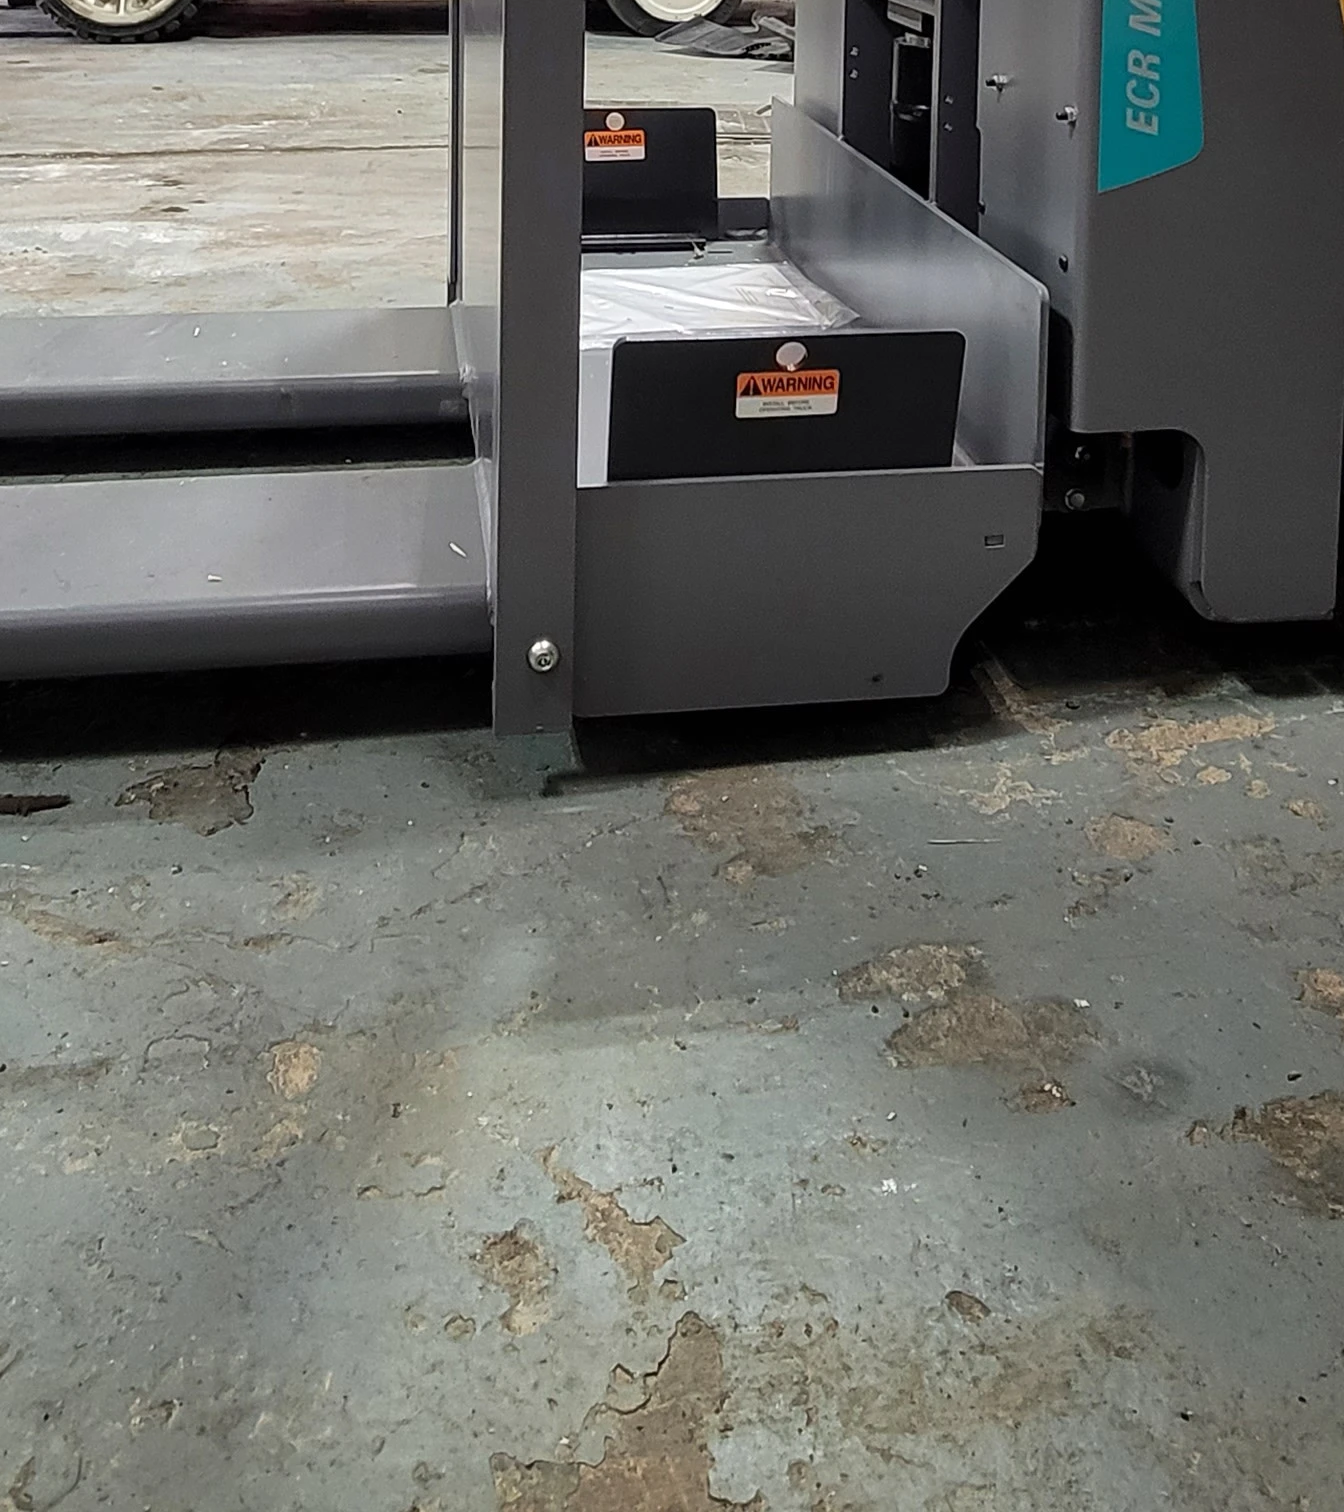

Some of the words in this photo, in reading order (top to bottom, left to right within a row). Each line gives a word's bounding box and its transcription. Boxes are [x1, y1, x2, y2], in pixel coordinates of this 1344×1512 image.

[1126, 49, 1161, 136] ECR
[598, 133, 642, 145] WARNING
[761, 375, 835, 393] WARNING
